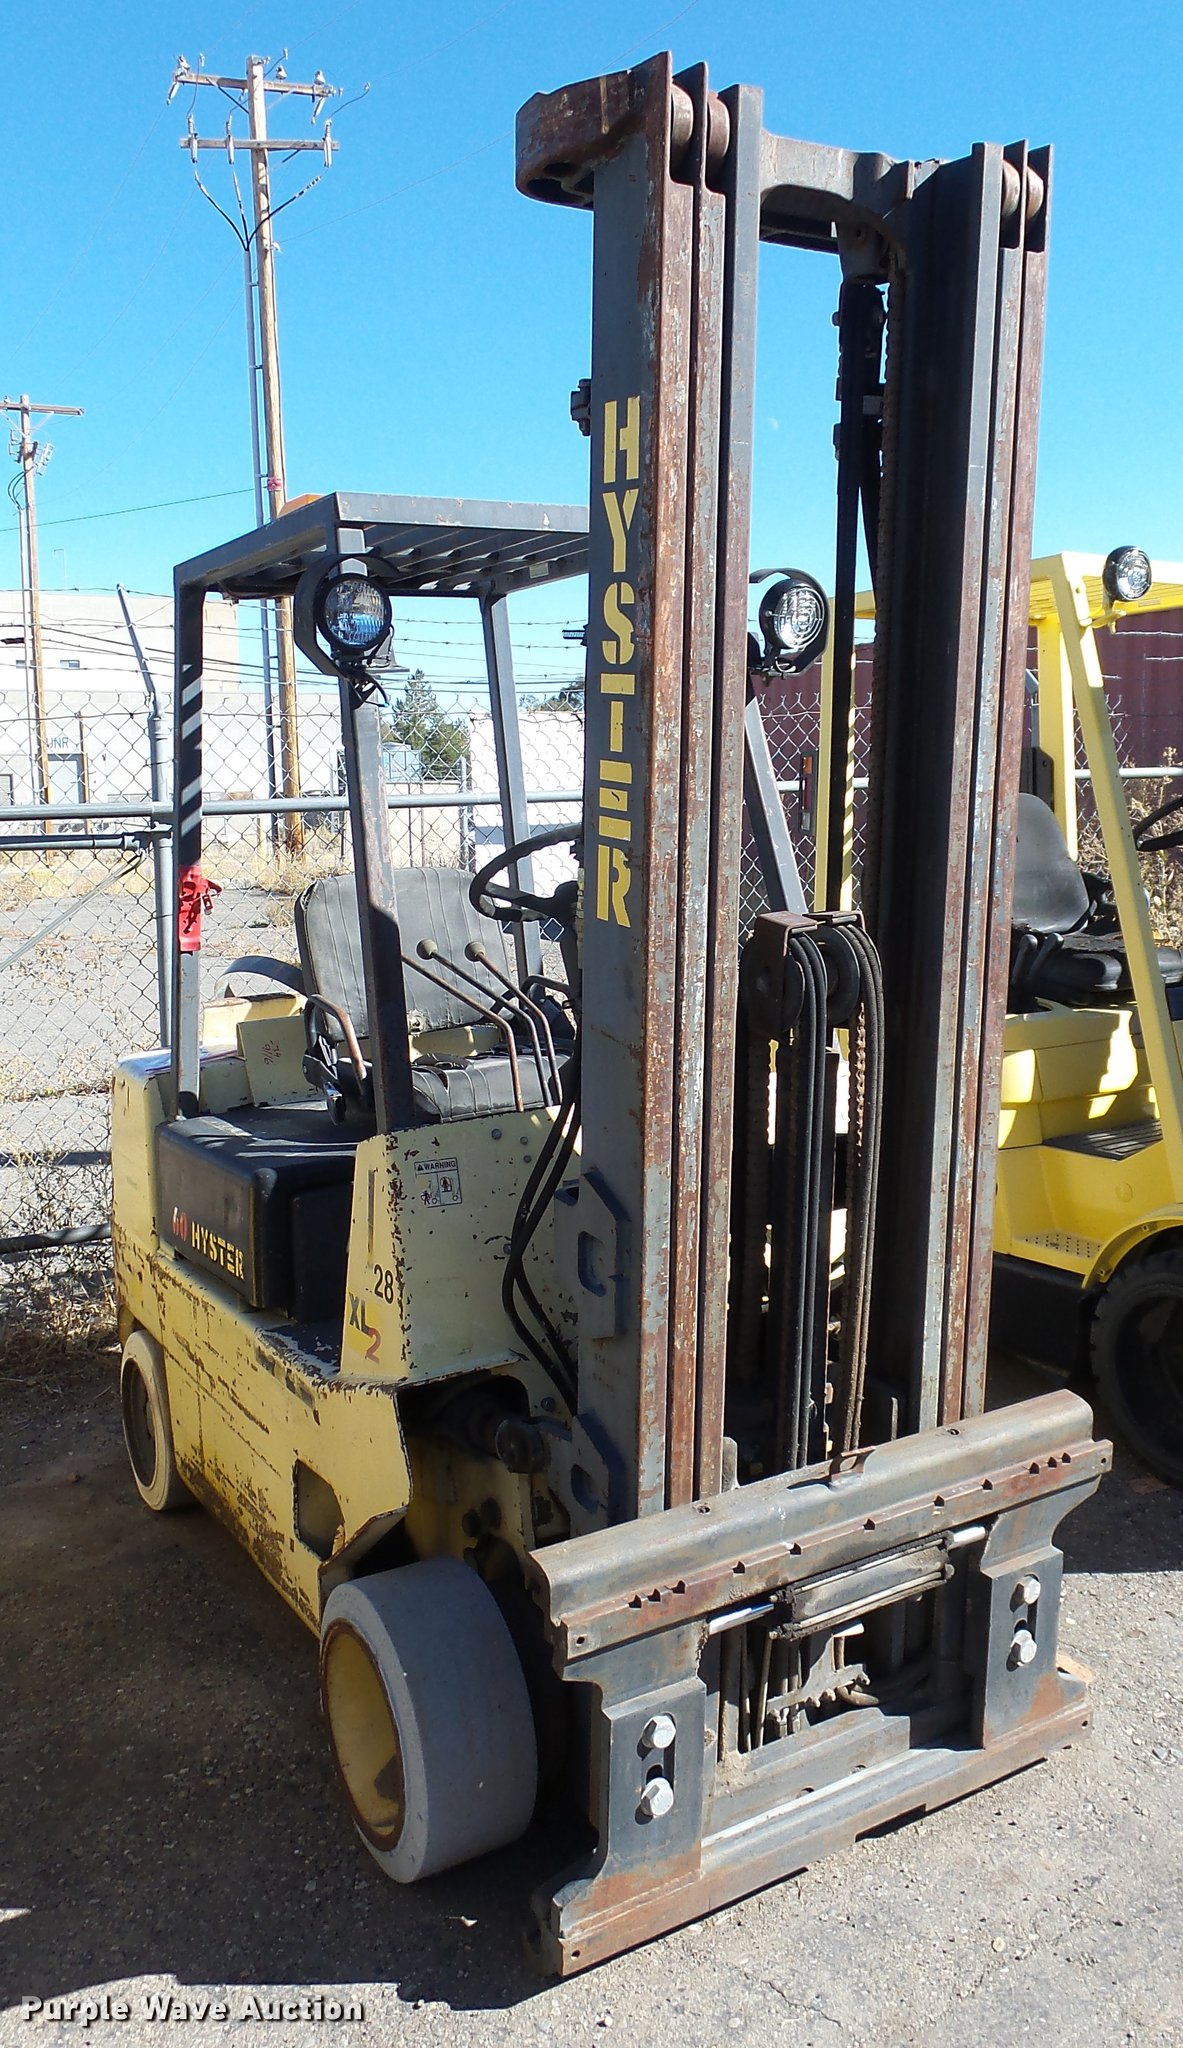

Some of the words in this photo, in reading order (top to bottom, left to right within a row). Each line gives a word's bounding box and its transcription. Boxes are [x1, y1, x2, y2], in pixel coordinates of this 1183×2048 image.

[597, 396, 641, 928] HYSTER
[423, 1160, 457, 1171] WARNING
[191, 1220, 245, 1281] HYSTER
[374, 1264, 395, 1305] 28
